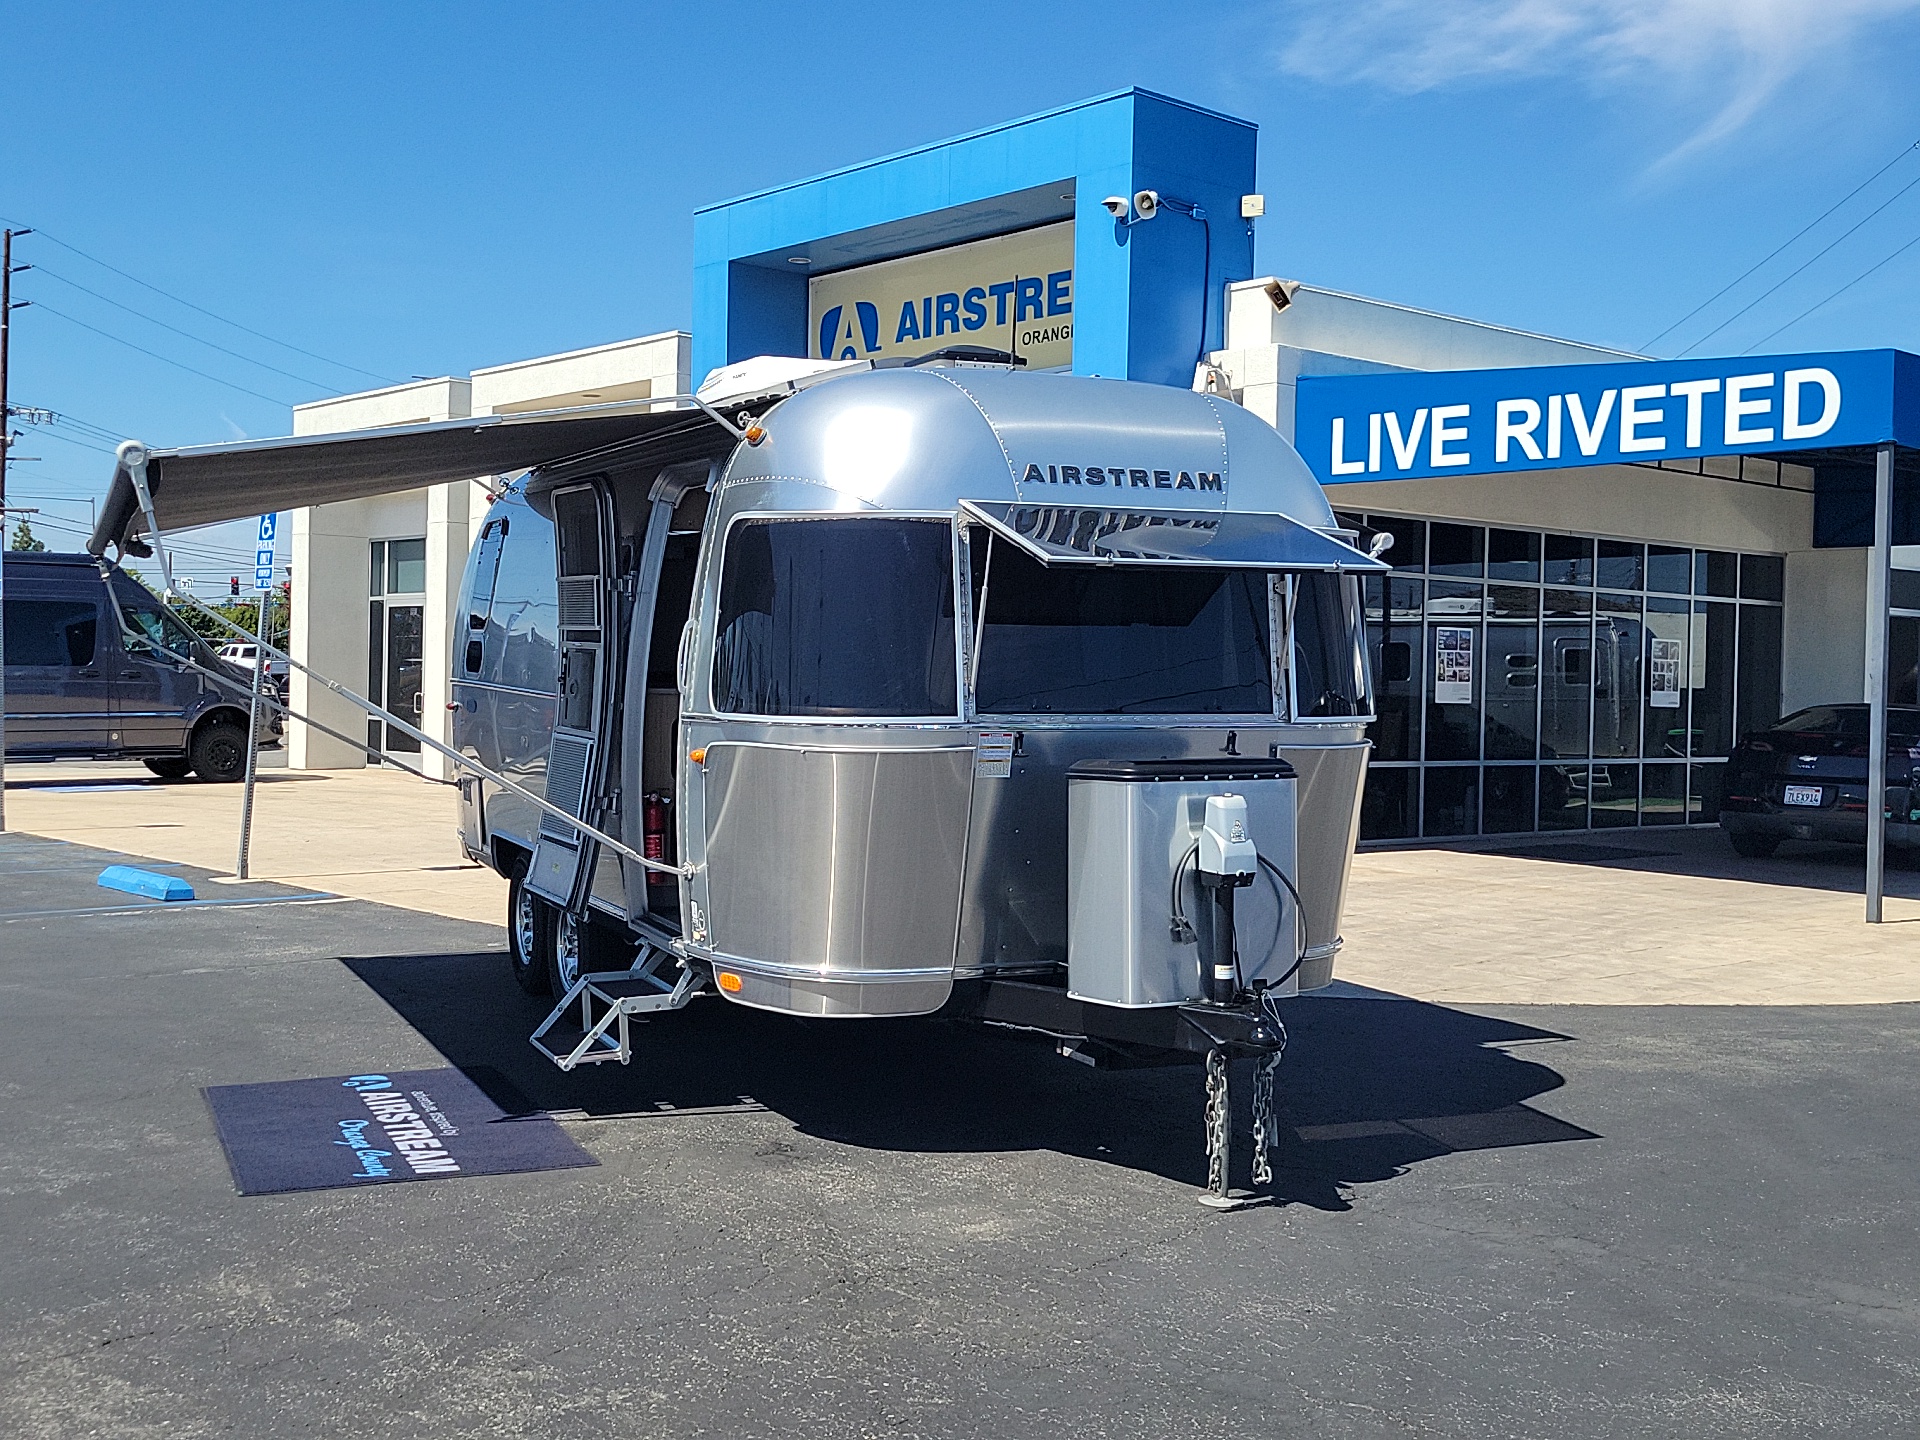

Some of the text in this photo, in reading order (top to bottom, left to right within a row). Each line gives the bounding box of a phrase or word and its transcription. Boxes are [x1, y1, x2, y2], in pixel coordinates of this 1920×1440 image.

[1022, 324, 1073, 346] ORANG
[1331, 367, 1841, 476] LIVE RIVETED
[1023, 463, 1222, 492] AIRSTREAM
[359, 1092, 461, 1174] AIRSTREAM
